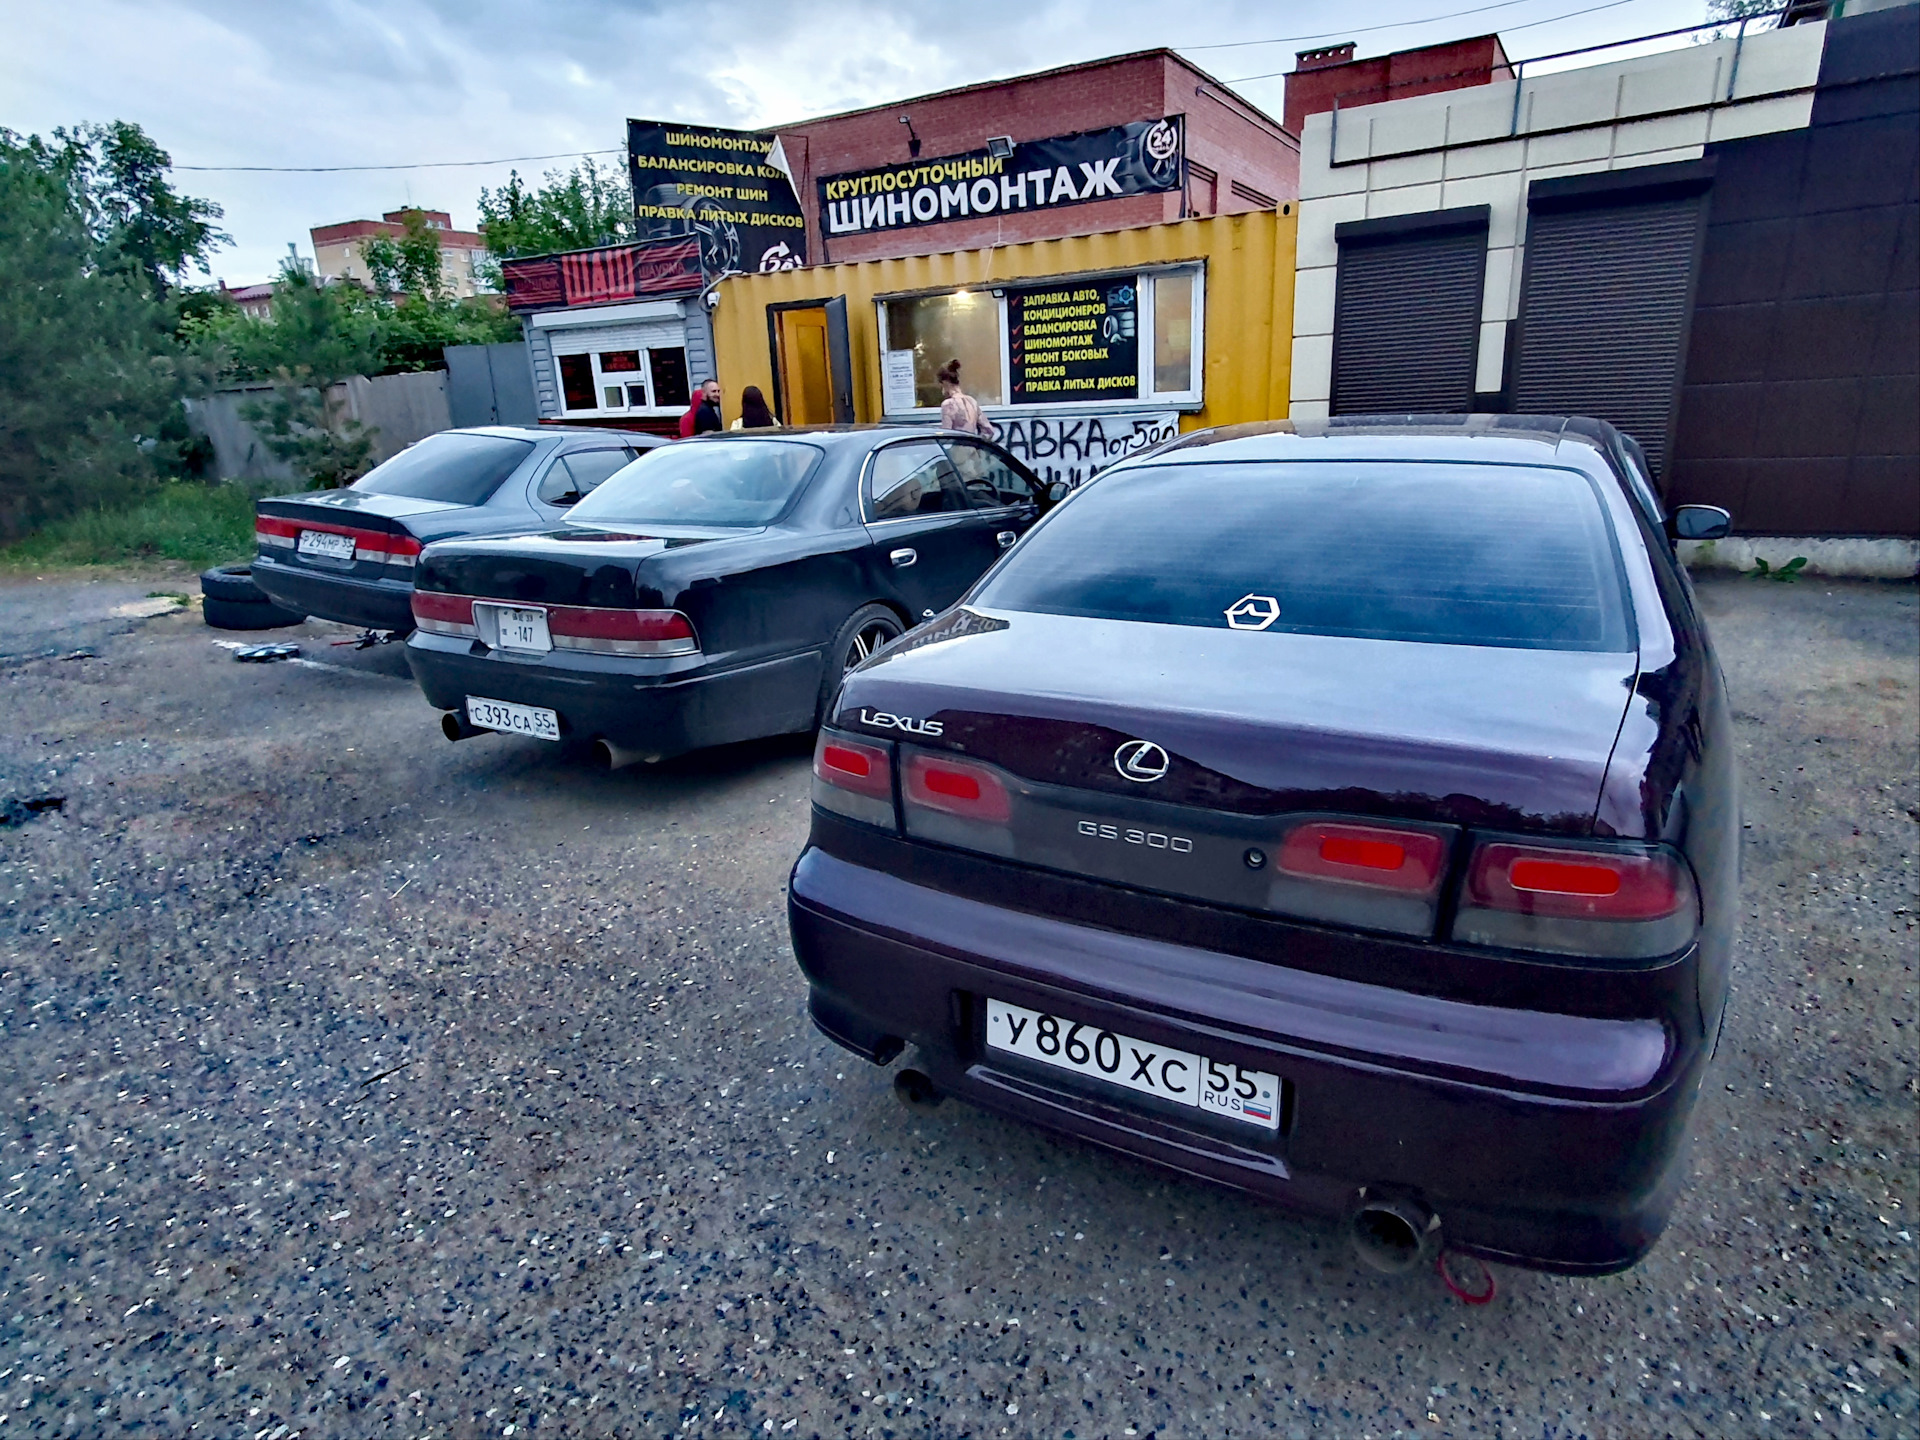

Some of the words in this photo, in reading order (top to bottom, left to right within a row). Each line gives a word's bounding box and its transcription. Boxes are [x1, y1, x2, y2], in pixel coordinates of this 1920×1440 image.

[666, 132, 773, 154] ШИНОМОНТАЖ
[1152, 130, 1172, 147] 24
[638, 155, 755, 177] БАЛАНСИРОВКА
[826, 156, 1003, 200] КРУГЛОСУТОЧНЫЙ
[676, 183, 733, 199] РЕМОНТ
[736, 187, 769, 202] ШИН
[828, 158, 1123, 234] ШИНОМОНТАЖ
[639, 205, 696, 220] ПРАВКА
[699, 209, 749, 225] ЛИТЫХ
[750, 212, 804, 229] ДИСКОВ
[561, 247, 636, 306] ШАШ
[1023, 291, 1071, 307] ЗАПРАВКА
[1023, 303, 1107, 321] КОНДИЦИОНЕРОВ
[1023, 319, 1098, 336] БАЛАНСИРОВКА
[1024, 334, 1094, 350] ШИНОМОНТАЖ
[1024, 351, 1060, 364] РЕМОНТ
[1061, 347, 1109, 362] БОКОВЫХ
[1025, 365, 1066, 378] ПОРЕЗОВ
[1025, 380, 1061, 392] ПРАВКА
[1063, 378, 1096, 390] ЛИТЫХ
[1097, 375, 1136, 390] ДИСКОВ
[860, 709, 944, 737] LEXUS
[1078, 820, 1118, 840] GS
[1124, 828, 1193, 853] 300
[1006, 1012, 1188, 1094] У860ХС
[1206, 1056, 1258, 1100] 55
[1204, 1090, 1241, 1112] RUS
